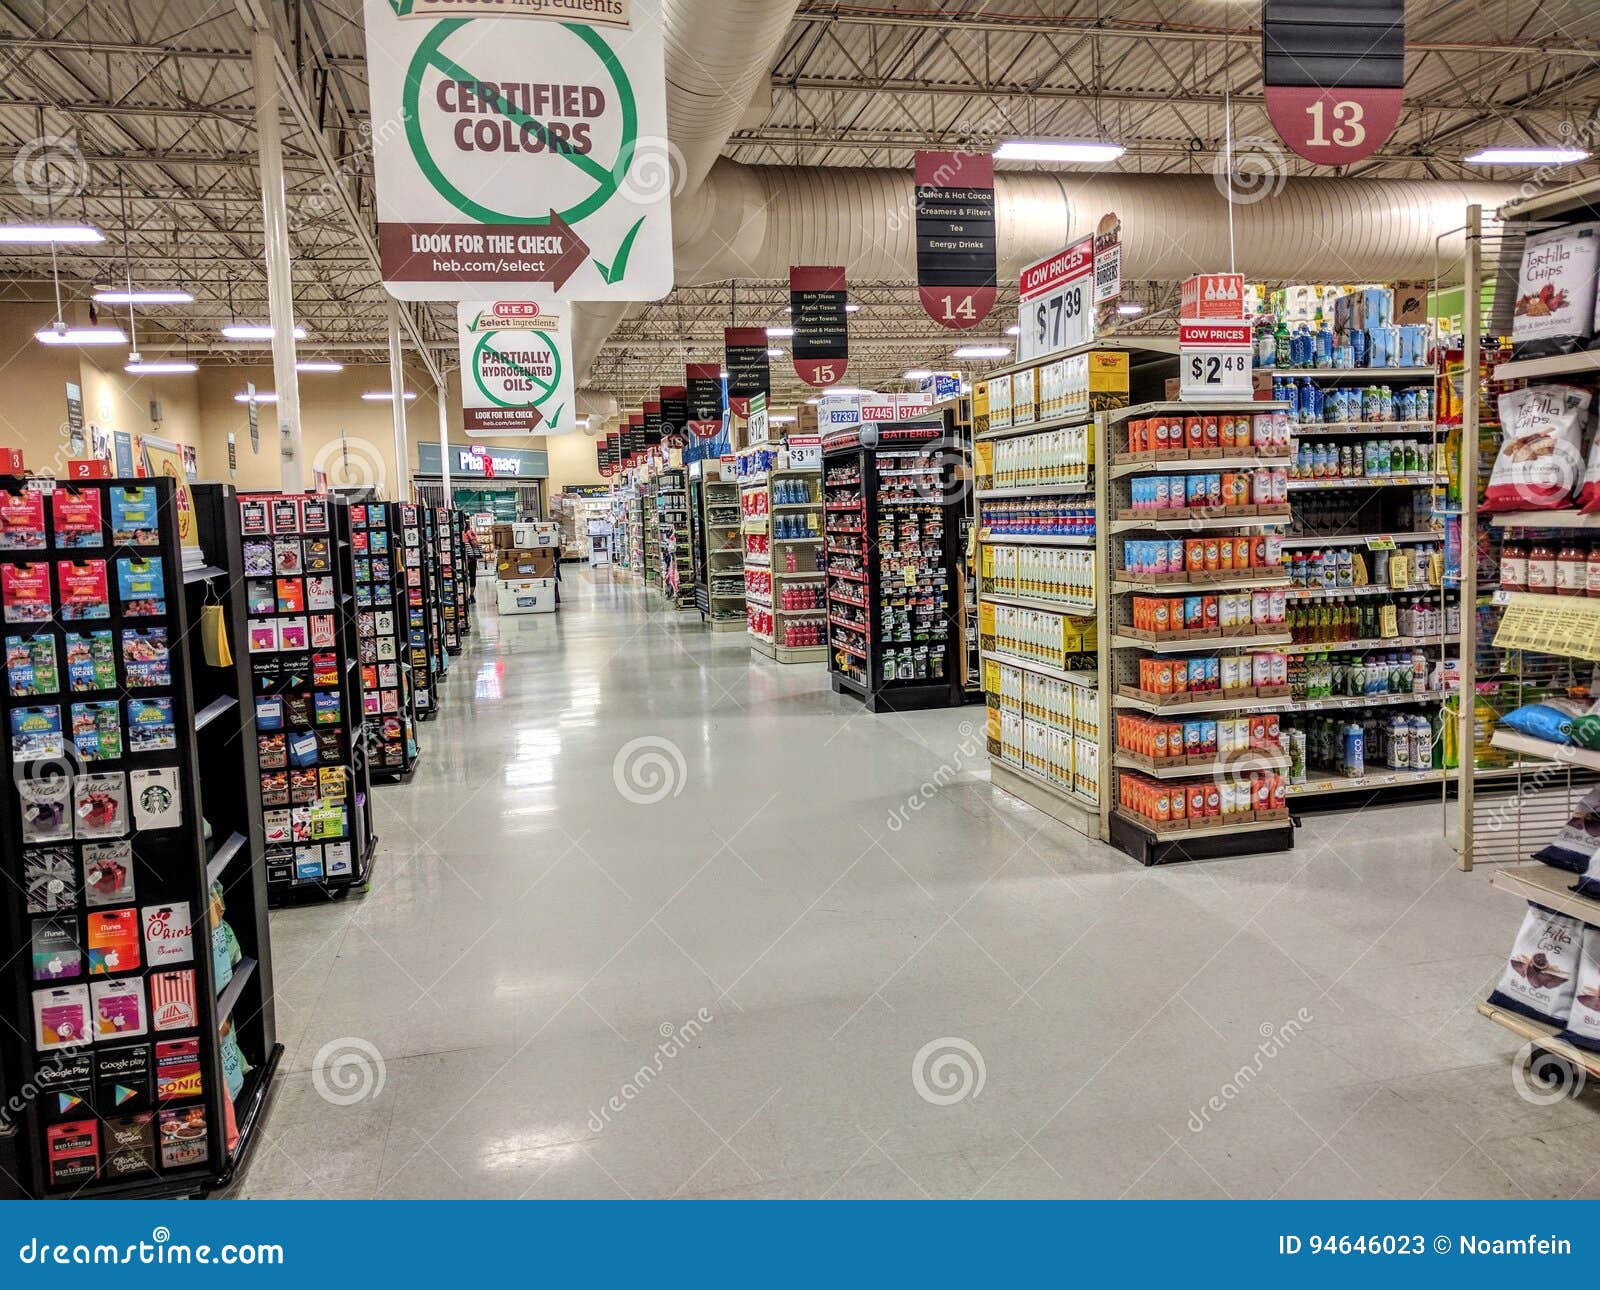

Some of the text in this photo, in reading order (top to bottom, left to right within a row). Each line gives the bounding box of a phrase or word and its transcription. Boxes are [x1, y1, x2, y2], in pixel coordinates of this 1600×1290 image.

[436, 79, 605, 118] CERTIFIED
[1305, 101, 1366, 148] 13
[454, 119, 593, 155] COLORS
[918, 191, 943, 200] Coffee
[952, 192, 966, 200] Hot
[967, 192, 992, 200] Cocoa
[920, 207, 992, 217] Creamers & Filters
[949, 224, 964, 232] Tea
[411, 234, 563, 255] LOOK FOR THE CHECK
[929, 240, 984, 249] Energy Drinks
[1526, 244, 1571, 268] Tortilla
[432, 258, 545, 274] heb.com/select
[1026, 250, 1084, 289] LOW PRICES
[940, 295, 977, 320] 14
[480, 319, 511, 327] Select
[1185, 329, 1245, 341] LOW PRICES
[482, 351, 551, 364] PARTIALLY
[482, 366, 553, 377] HYDROGENATED
[812, 364, 835, 384] 15
[503, 378, 533, 392] OILS
[741, 401, 750, 415] 1
[863, 407, 893, 419] 37445
[475, 411, 534, 420] LOOK FOR THE CHECK
[832, 411, 858, 422] 37337
[699, 424, 716, 436] 17
[882, 430, 940, 440] BATTERIES
[13, 454, 20, 468] 3
[78, 464, 90, 477] 2
[101, 923, 122, 932] iTunes
[44, 930, 66, 938] iTunes
[1584, 1015, 1600, 1026] Blu
[100, 1059, 129, 1070] Google
[42, 1066, 90, 1079] Google Play
[157, 1078, 202, 1094] SONIC
